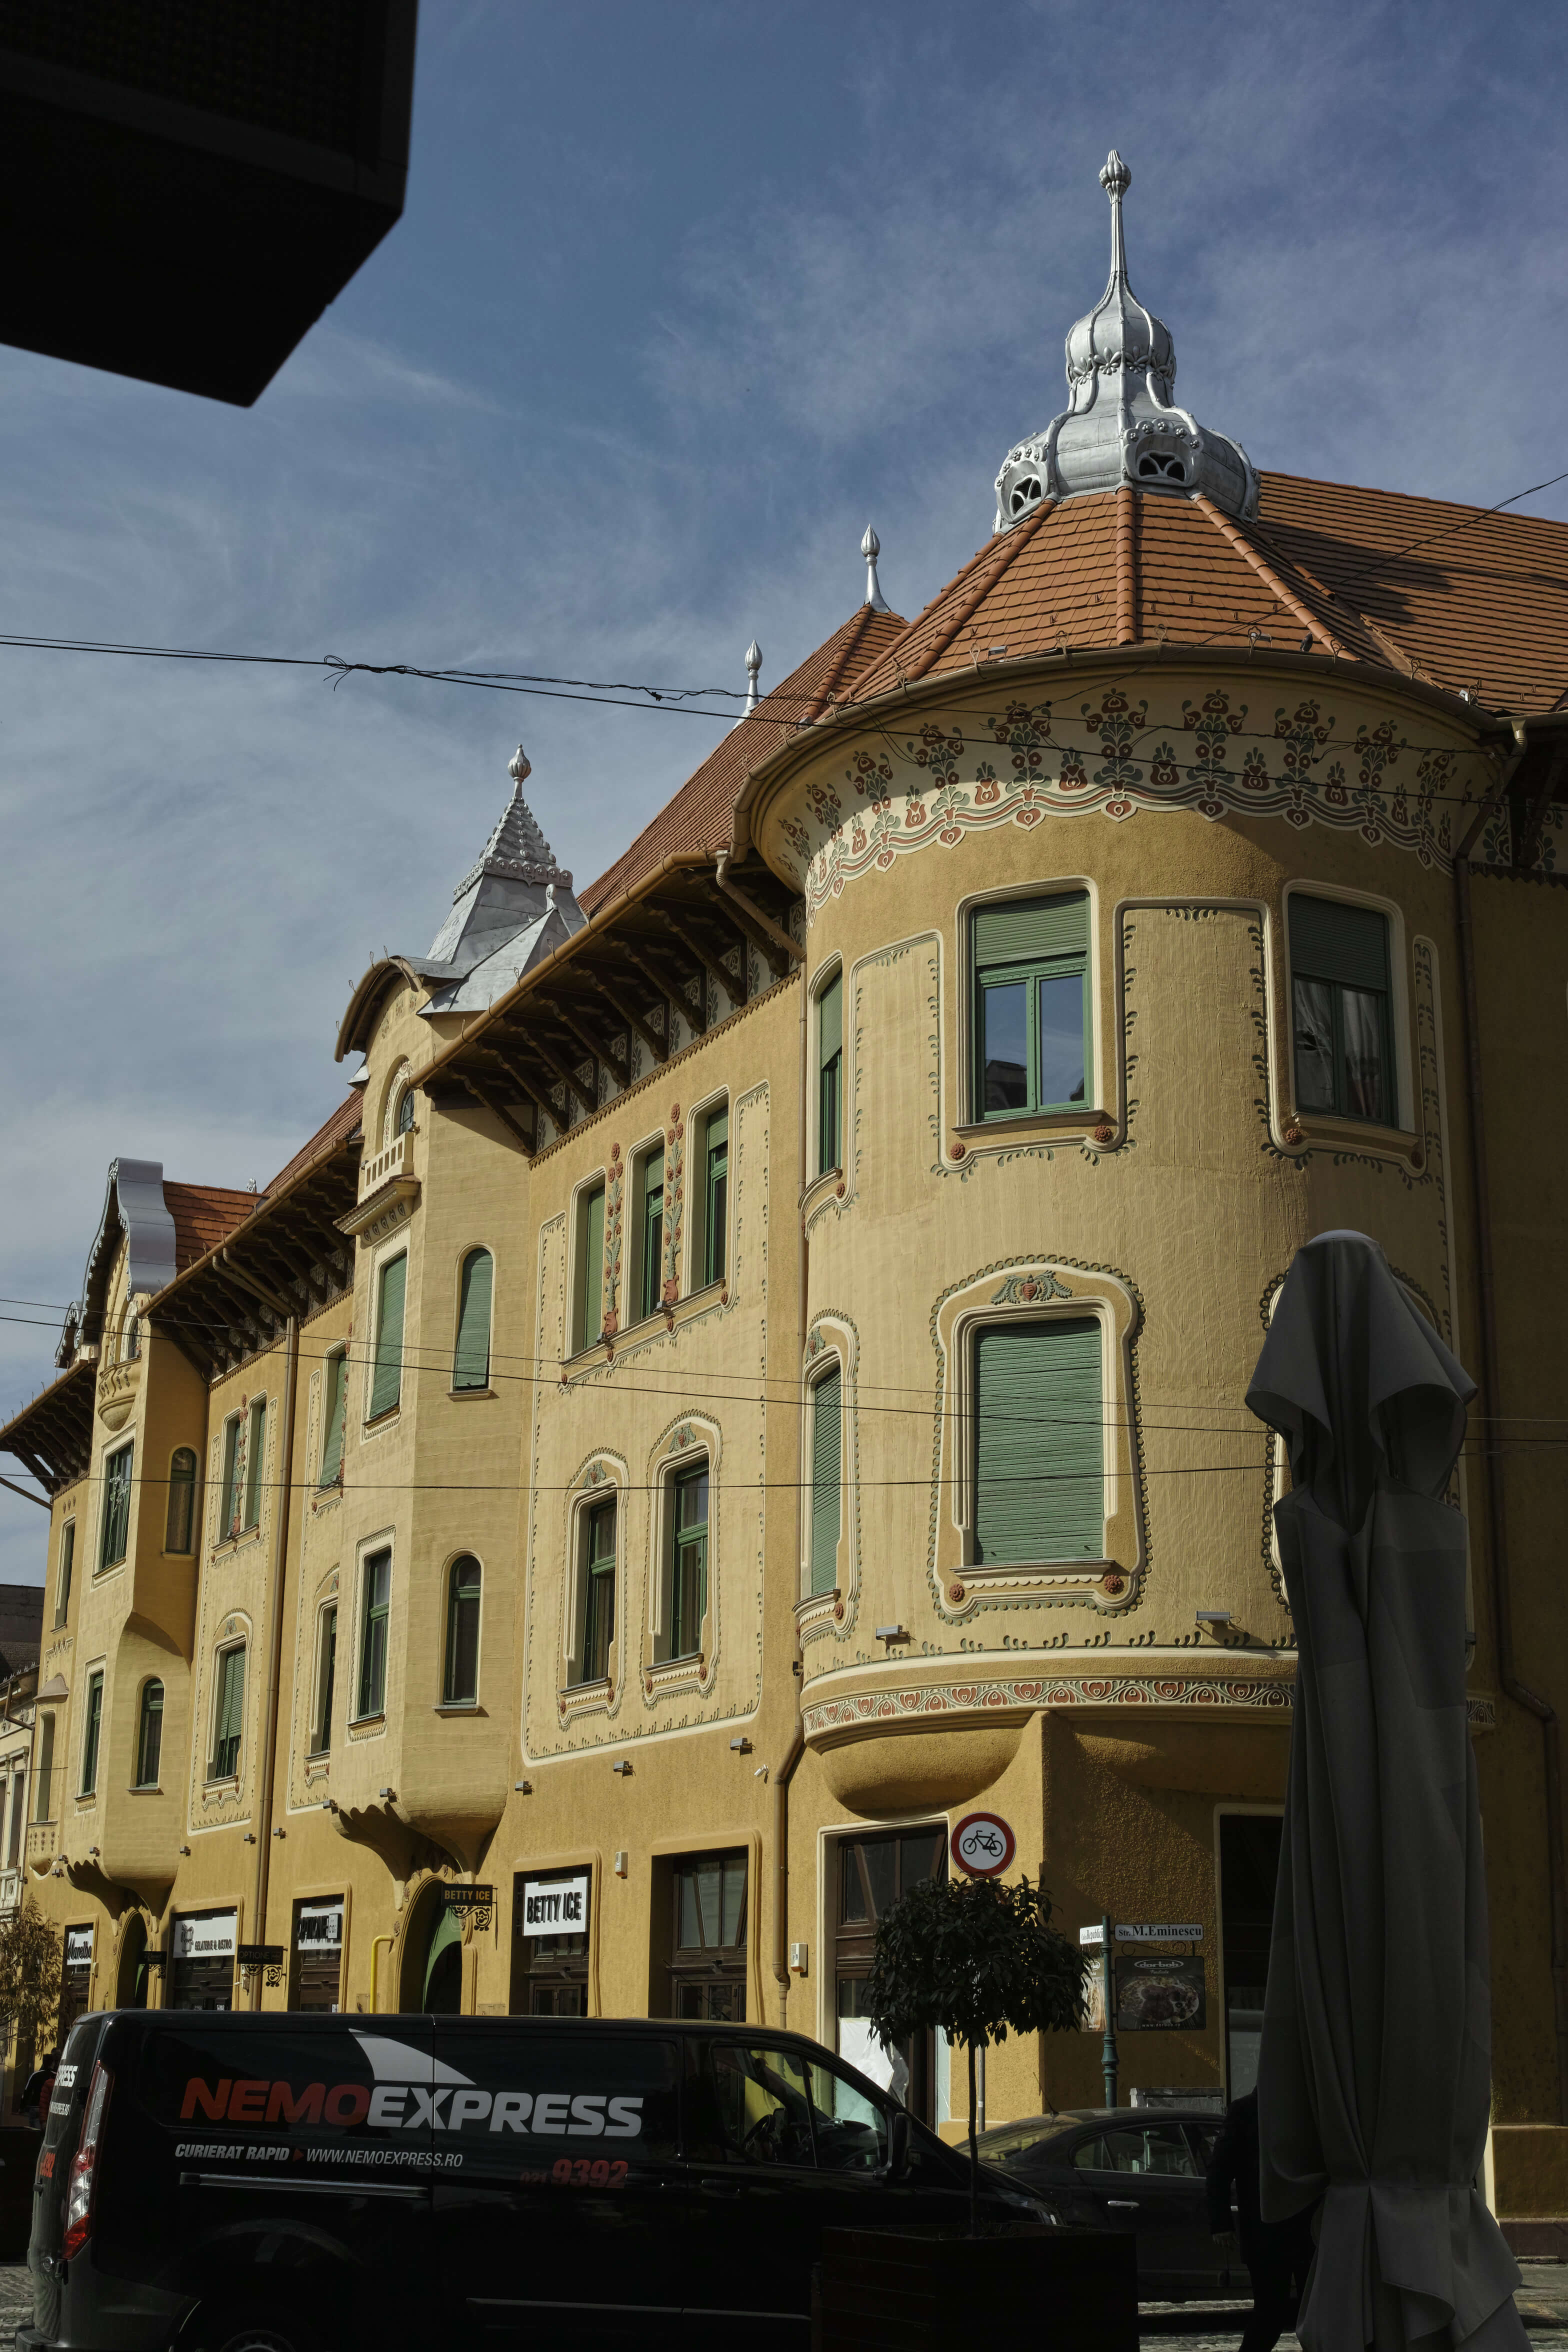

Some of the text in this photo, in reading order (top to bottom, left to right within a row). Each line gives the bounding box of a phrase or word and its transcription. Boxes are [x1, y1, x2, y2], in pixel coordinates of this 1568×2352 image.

[444, 1890, 490, 1900] BETTY ICE
[527, 1892, 582, 1924] BETTY ICE
[1132, 1926, 1201, 1936] M.Eminescu
[195, 1940, 213, 1951] GELATERIE
[218, 1938, 232, 1950] BISTRO
[176, 2144, 463, 2167] CURIERAT RAPID WWW.NEMOEXPRESS.RO
[552, 2159, 628, 2188] 9392
